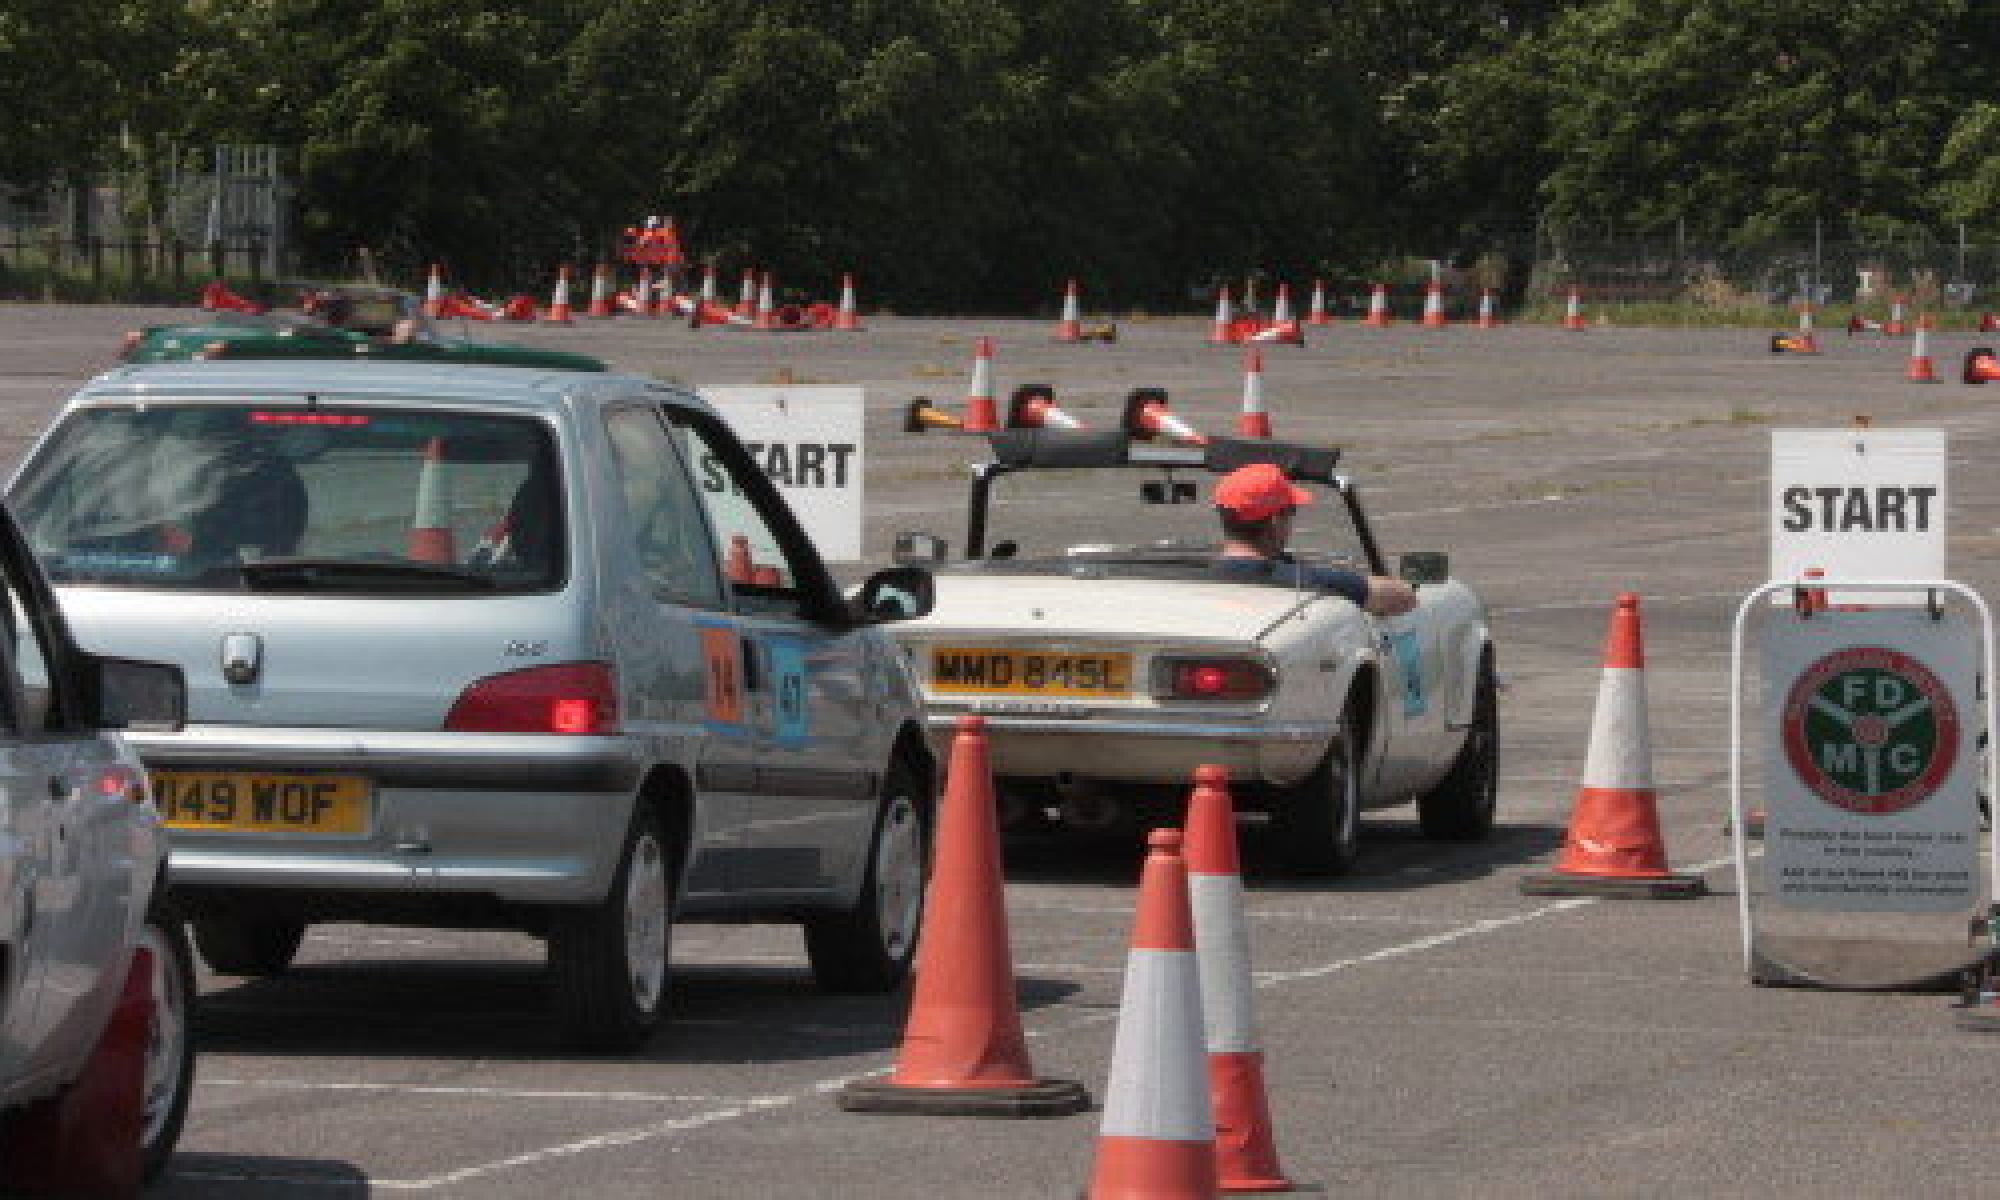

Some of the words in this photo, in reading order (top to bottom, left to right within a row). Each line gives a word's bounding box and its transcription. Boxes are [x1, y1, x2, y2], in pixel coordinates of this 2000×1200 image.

[1783, 483, 1937, 533] START
[935, 654, 1013, 689] MMD
[1024, 656, 1125, 692] 845L
[1842, 675, 1905, 708] FD
[251, 779, 337, 825] WOF
